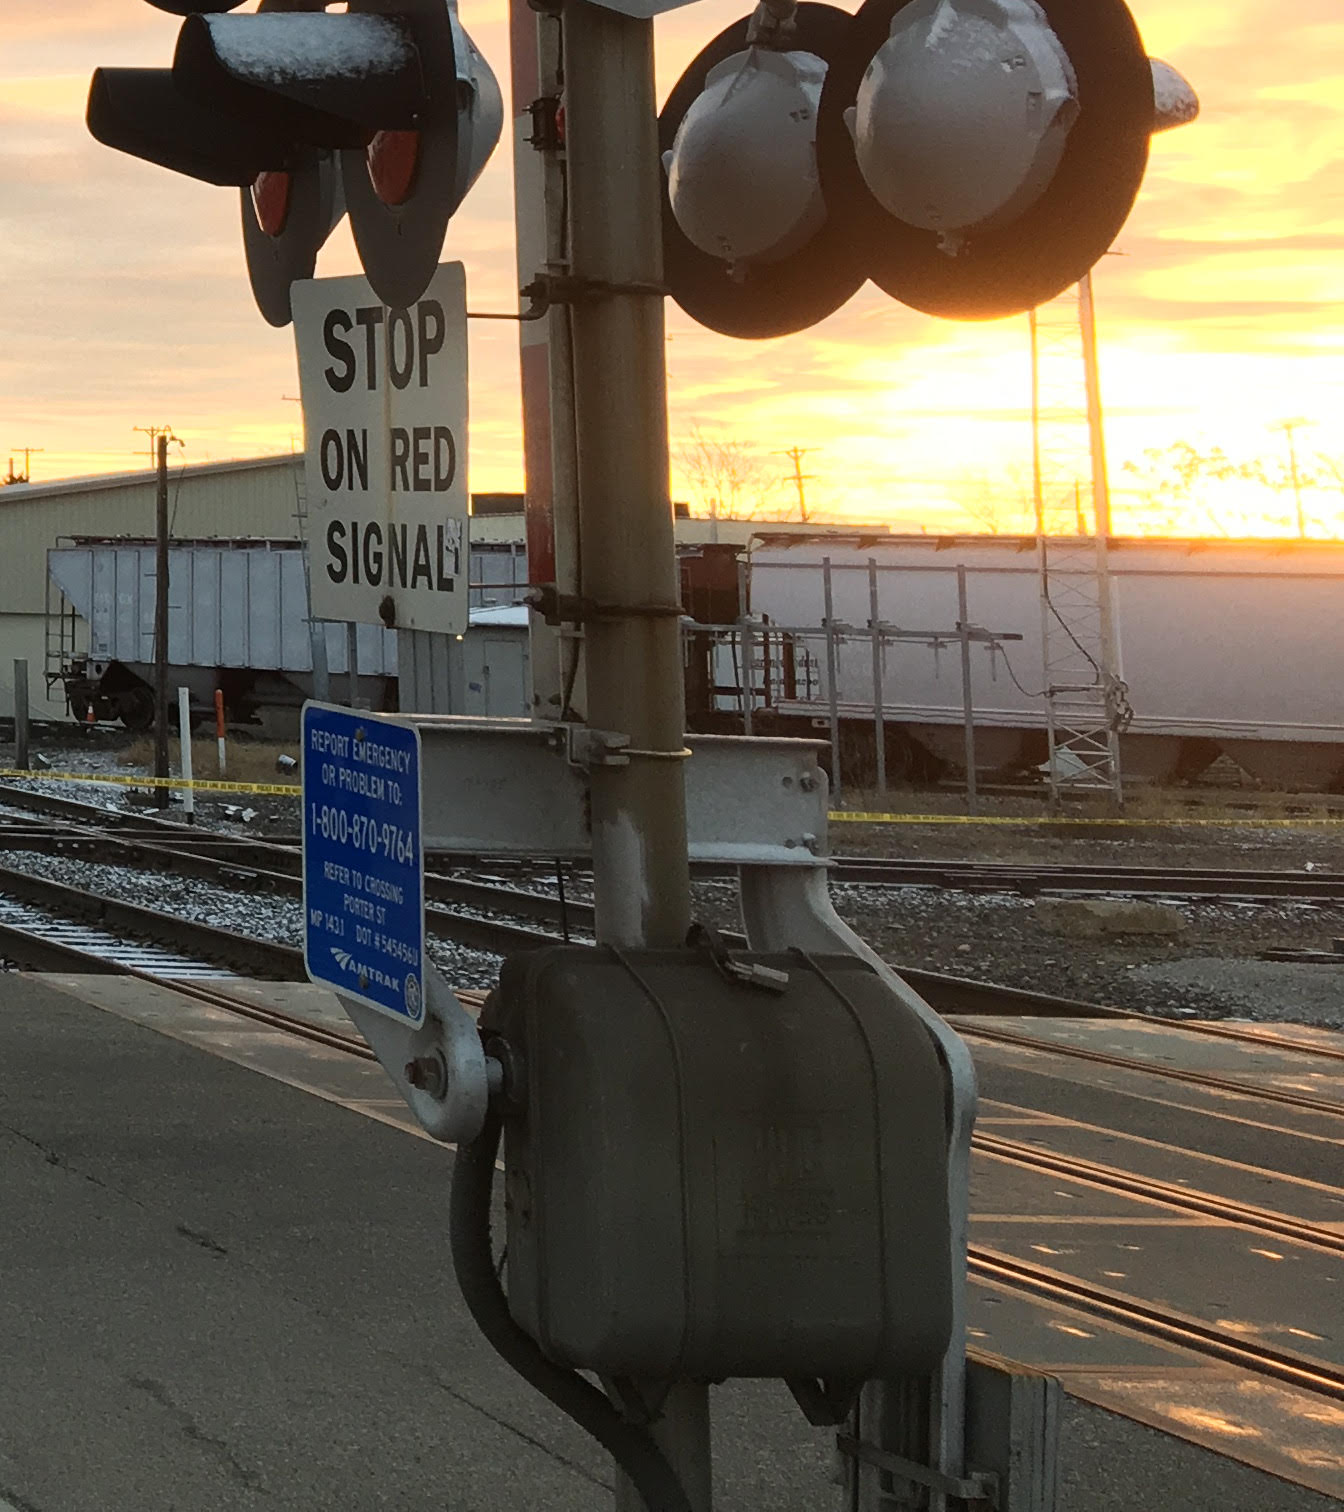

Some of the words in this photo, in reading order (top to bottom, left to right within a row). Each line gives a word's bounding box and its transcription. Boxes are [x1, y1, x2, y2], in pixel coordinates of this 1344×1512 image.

[323, 299, 446, 393] STOP
[320, 427, 368, 491] ON
[391, 425, 456, 492] RED
[326, 519, 454, 592] SIGNAL
[312, 728, 349, 758] REPORT
[353, 738, 410, 774] EMERGENCY
[322, 763, 336, 787] OR
[339, 767, 384, 801] PROBLEM
[387, 780, 402, 806] TO:
[312, 802, 413, 867] 1-800-870-9764
[324, 860, 350, 886] REFER
[352, 869, 362, 890] TO
[364, 874, 404, 905] CROSSING
[311, 908, 323, 927] MP
[356, 924, 372, 946] DOT
[343, 893, 374, 922] PORTER
[376, 905, 386, 925] ST
[348, 959, 400, 992] AMTRAK
